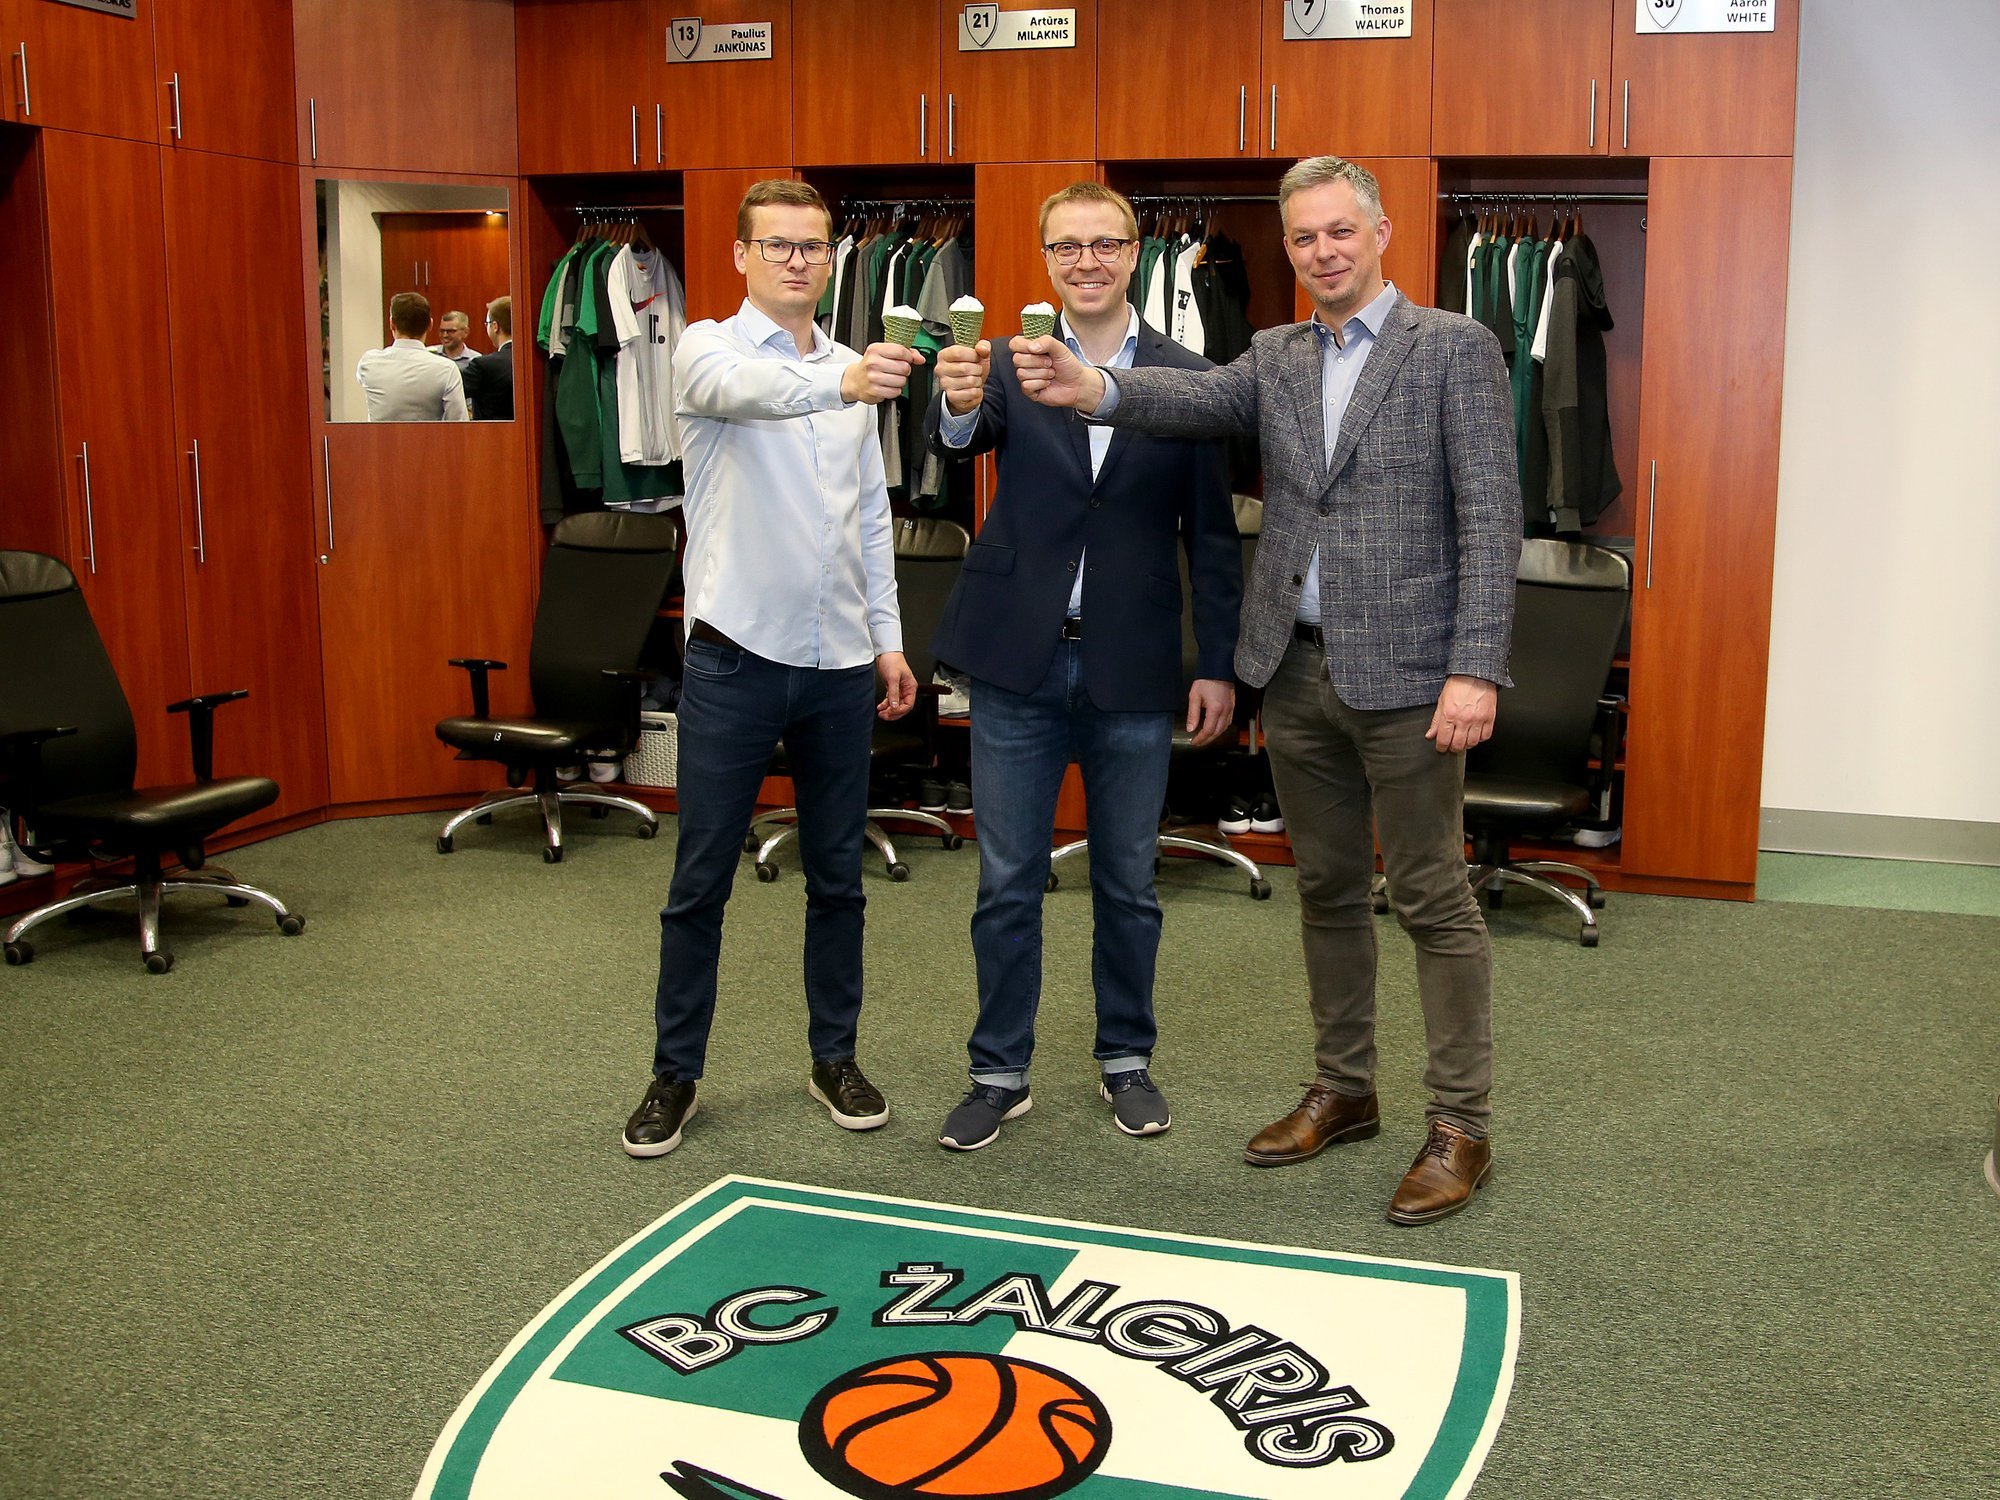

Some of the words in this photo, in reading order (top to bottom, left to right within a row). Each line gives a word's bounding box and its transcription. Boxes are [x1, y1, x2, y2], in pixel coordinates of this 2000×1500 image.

[1304, 0, 1314, 15] 7
[1361, 5, 1404, 15] Thomas
[973, 13, 989, 28] 21
[1030, 16, 1069, 26] Artūras
[1727, 12, 1766, 22] WHITE
[1355, 19, 1404, 30] WALKUP
[678, 26, 694, 41] 13
[731, 29, 765, 39] Paulius
[1017, 30, 1069, 41] MILAKNIS
[713, 41, 765, 53] JANKŪNAS
[904, 520, 913, 529] 21
[616, 1286, 838, 1376] BC
[872, 1262, 1395, 1469] ŽALGIRIS
